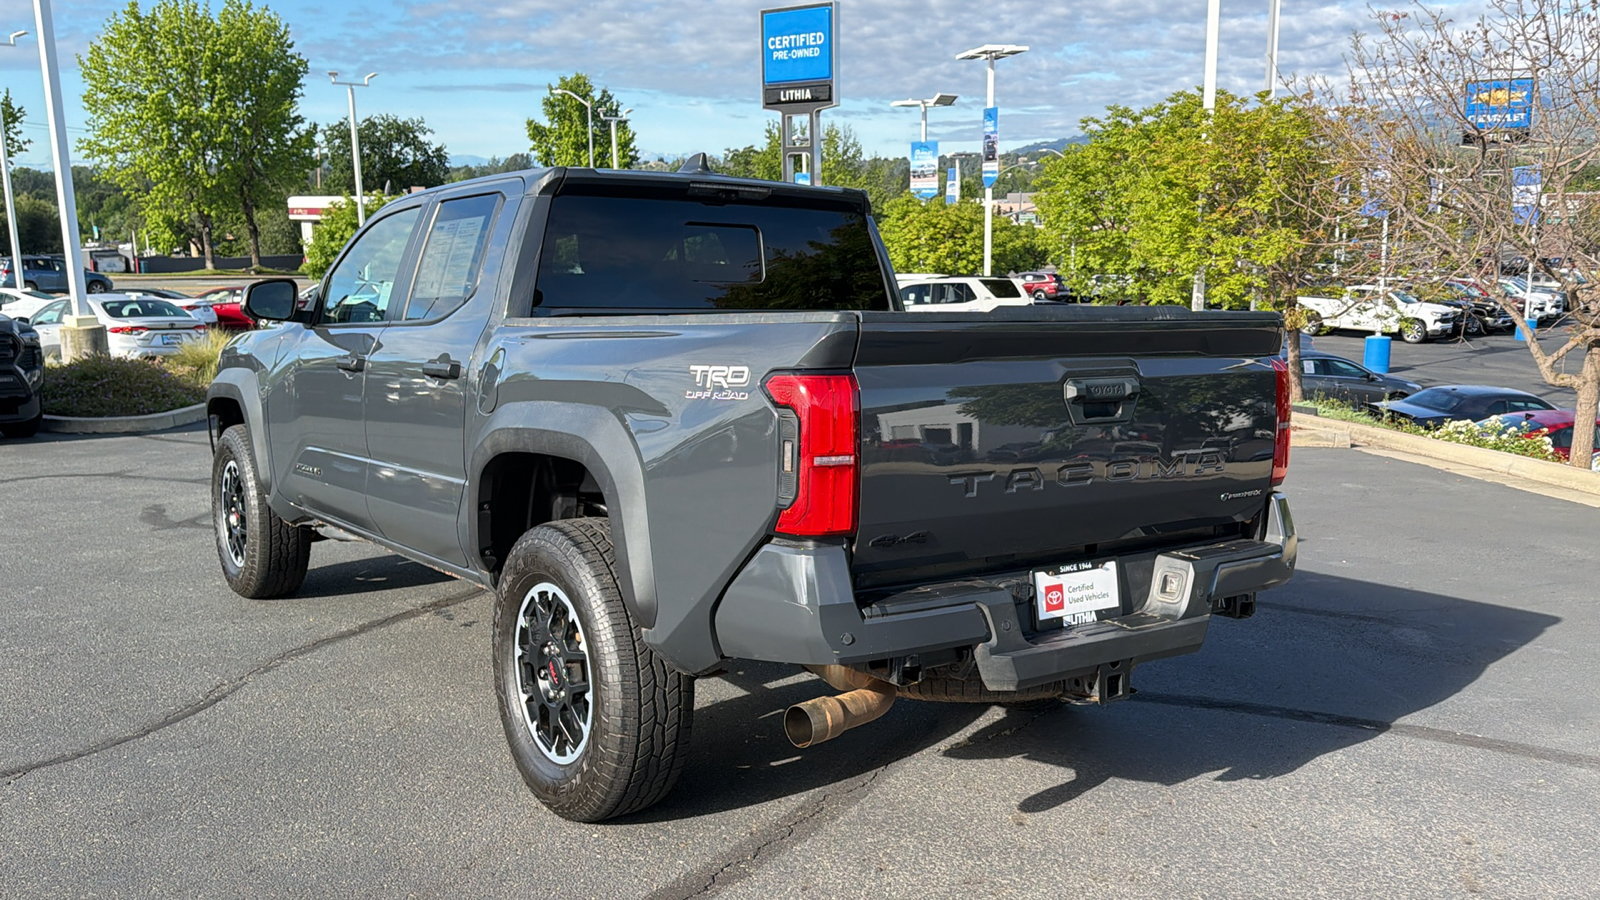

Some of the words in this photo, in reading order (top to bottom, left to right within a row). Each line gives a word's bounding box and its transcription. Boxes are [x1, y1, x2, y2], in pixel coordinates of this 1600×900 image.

[768, 32, 825, 49] CERTIFIED
[773, 47, 820, 60] PRE-OWNED
[780, 88, 812, 101] LITHIA
[689, 365, 751, 390] TRD
[685, 390, 712, 400] OFF
[712, 391, 749, 400] ROAD
[1090, 385, 1125, 395] TOYOTA
[946, 453, 1226, 498] TACOMA
[1060, 564, 1078, 573] SINCE
[1079, 562, 1092, 570] 1946
[1068, 583, 1094, 594] Certified
[1068, 594, 1084, 605] Used
[1085, 592, 1109, 602] Vehicles
